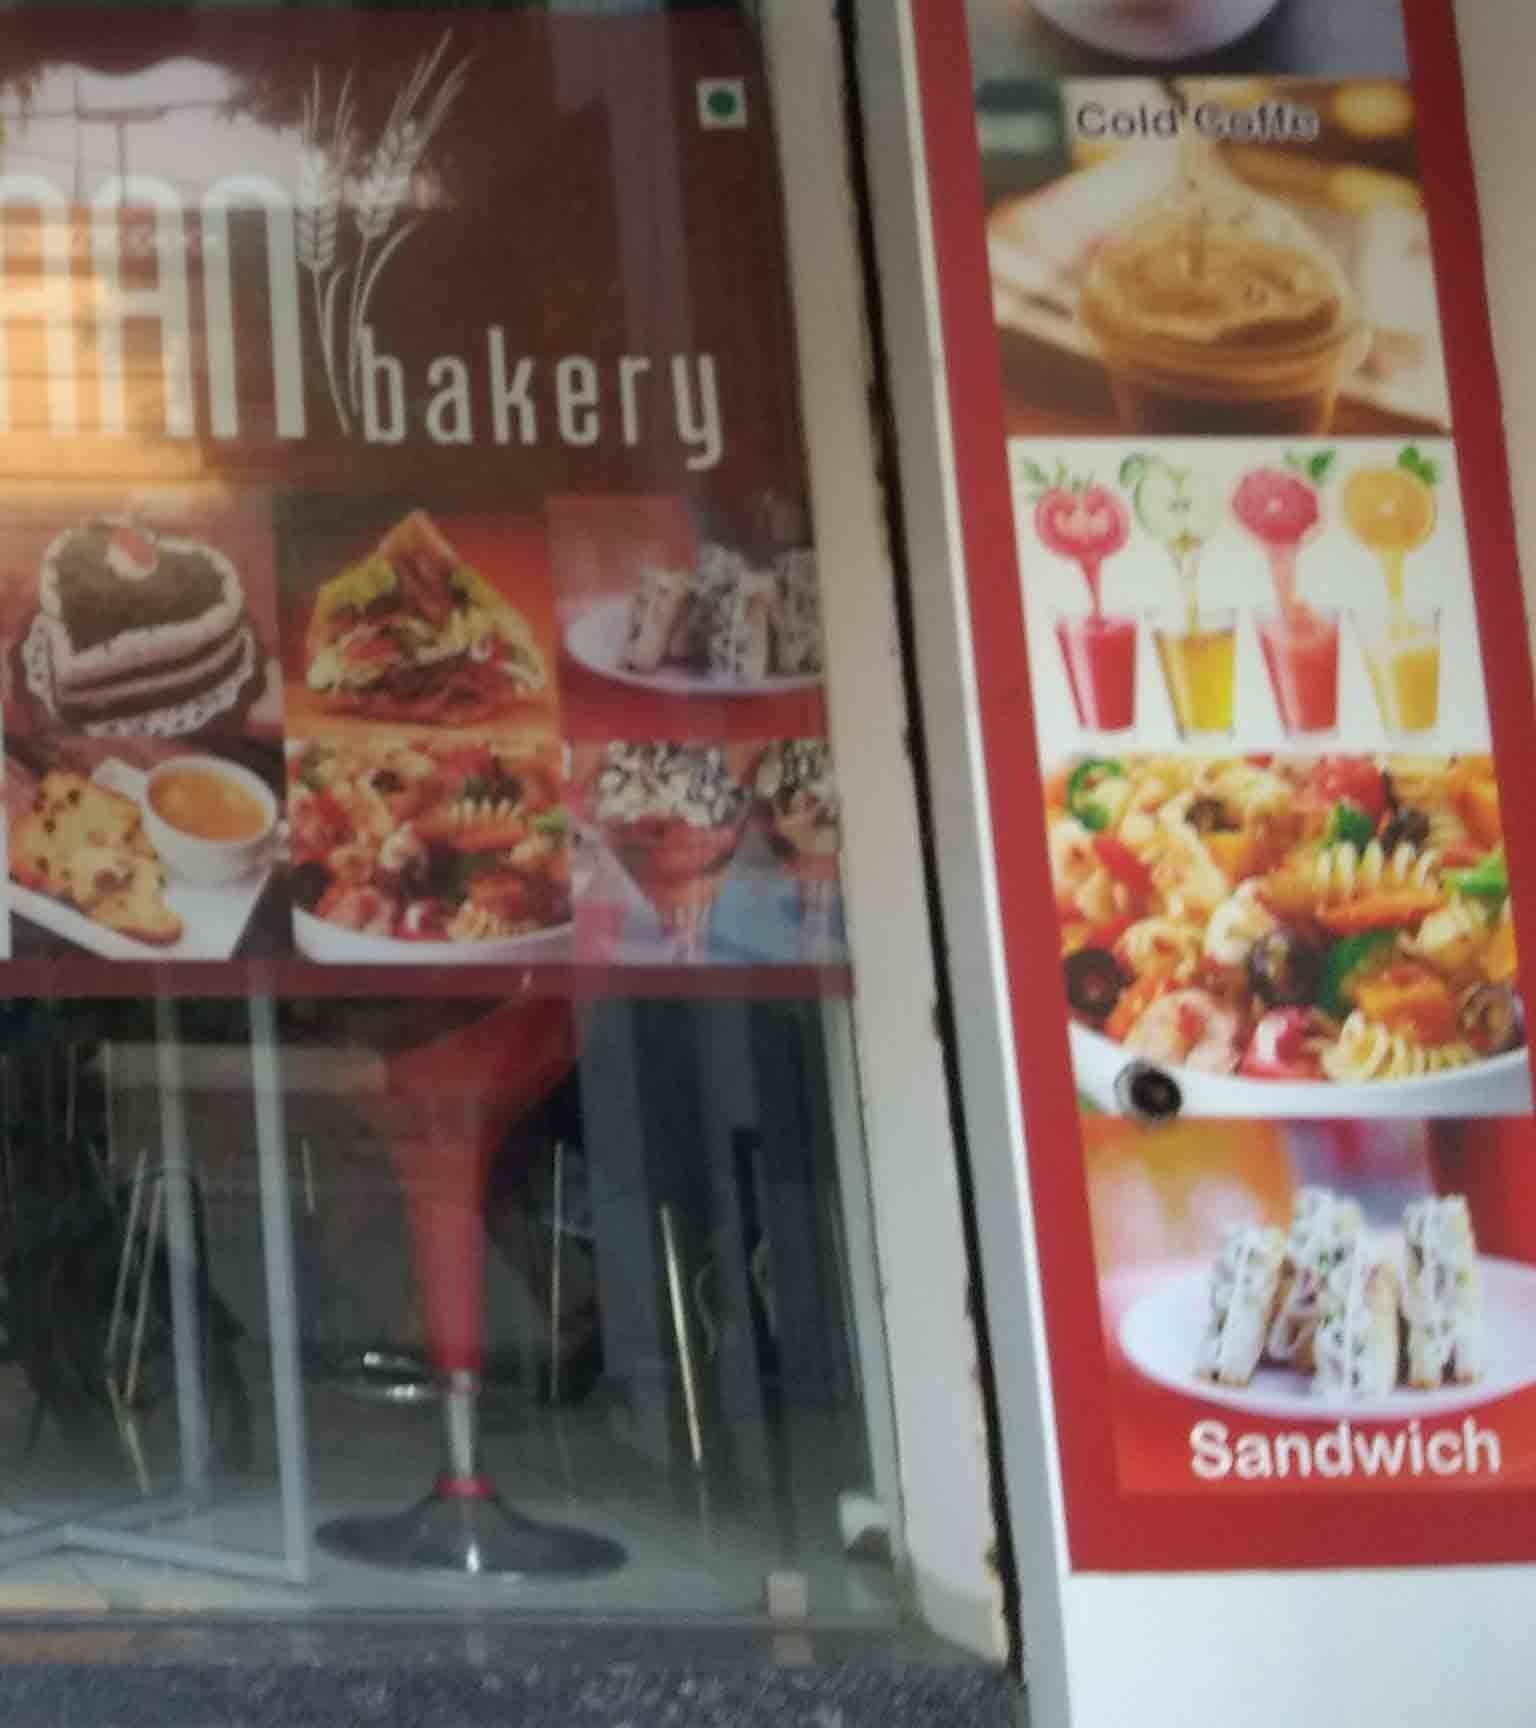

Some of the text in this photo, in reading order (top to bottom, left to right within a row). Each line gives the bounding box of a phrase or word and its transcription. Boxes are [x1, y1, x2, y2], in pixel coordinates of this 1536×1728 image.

[1075, 101, 1179, 140] Cold
[360, 327, 726, 470] bakery
[1189, 1418, 1502, 1478] Sandwich
